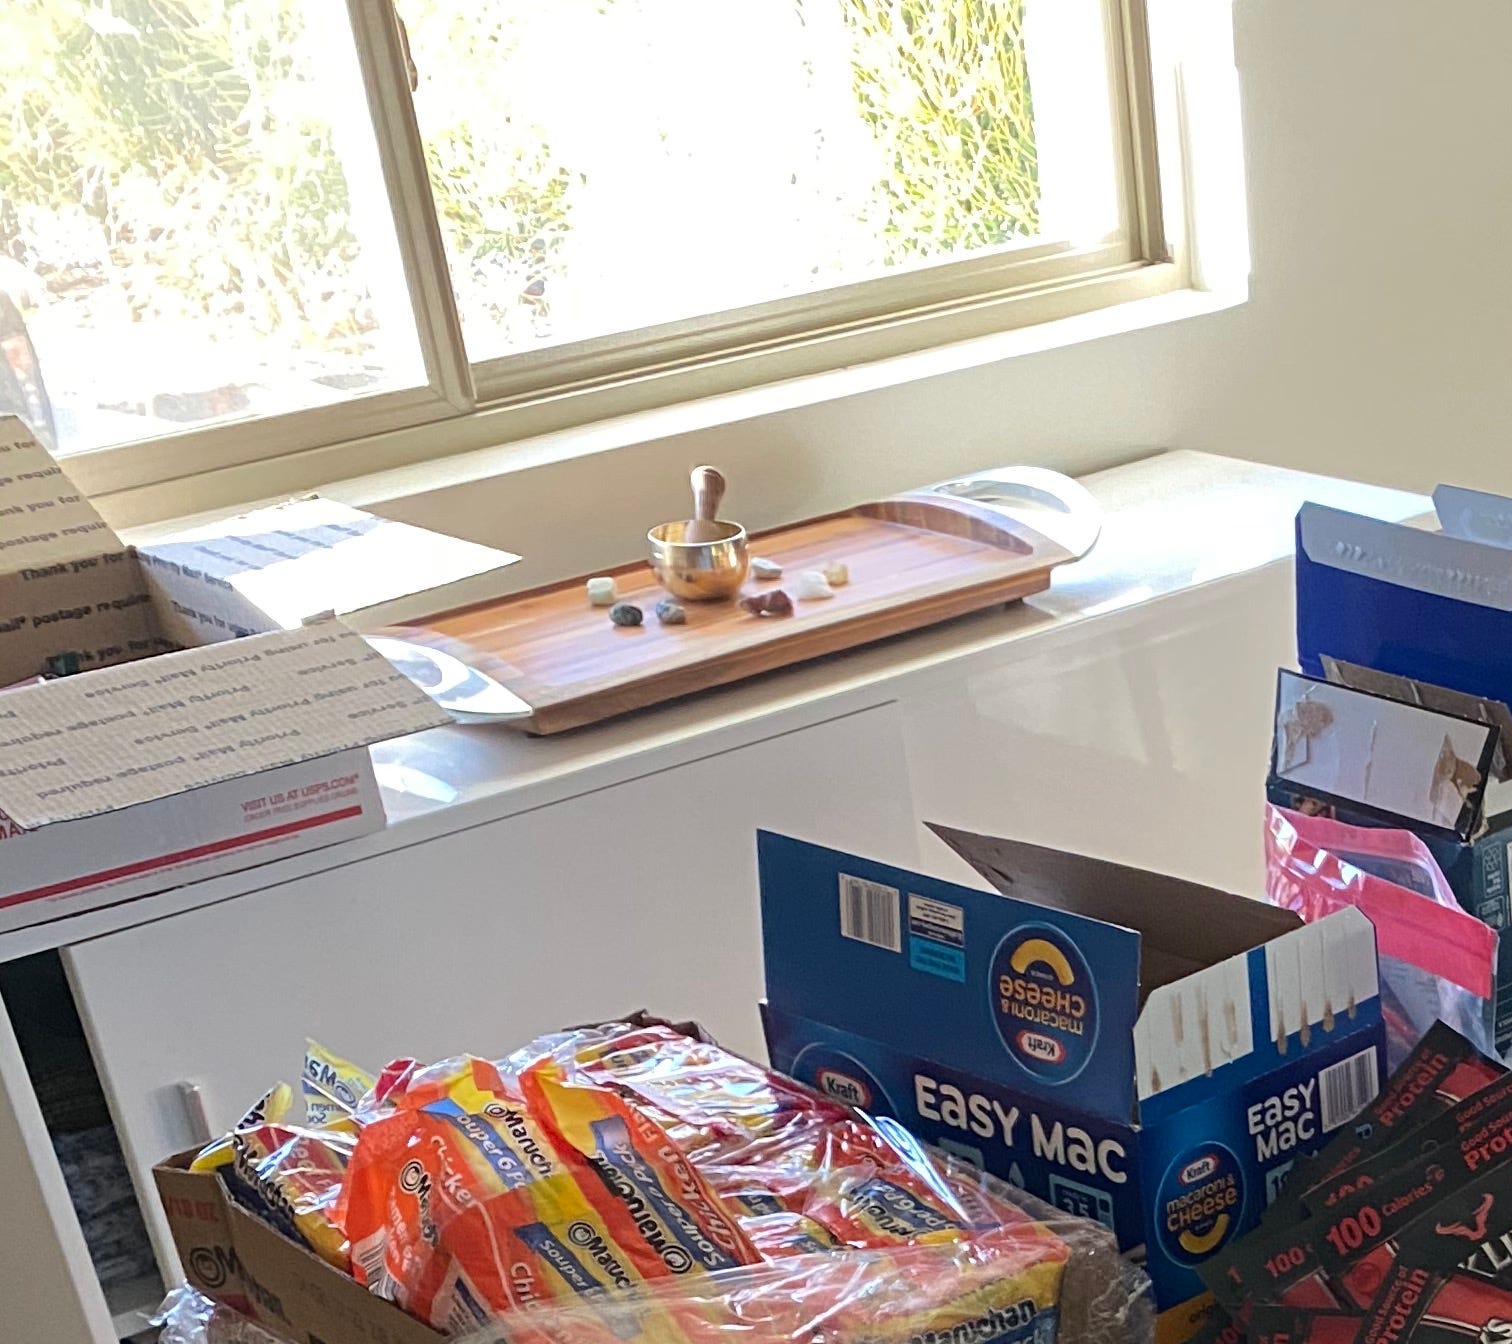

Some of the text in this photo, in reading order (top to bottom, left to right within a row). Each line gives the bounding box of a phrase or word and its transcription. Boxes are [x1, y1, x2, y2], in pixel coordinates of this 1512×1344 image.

[19, 563, 67, 581] Thank
[32, 606, 93, 629] postage
[84, 654, 262, 698] Priority Service
[188, 684, 250, 704] Priority
[134, 698, 311, 745] Priority Service
[1027, 1033, 1055, 1056] Kraft
[826, 1075, 860, 1101] Kraft
[1379, 1053, 1449, 1127] Protein
[1167, 1178, 1225, 1213] macaroni
[1327, 1182, 1433, 1256] 100 Calories
[539, 1239, 589, 1288] Souper
[1265, 1247, 1305, 1278] 100
